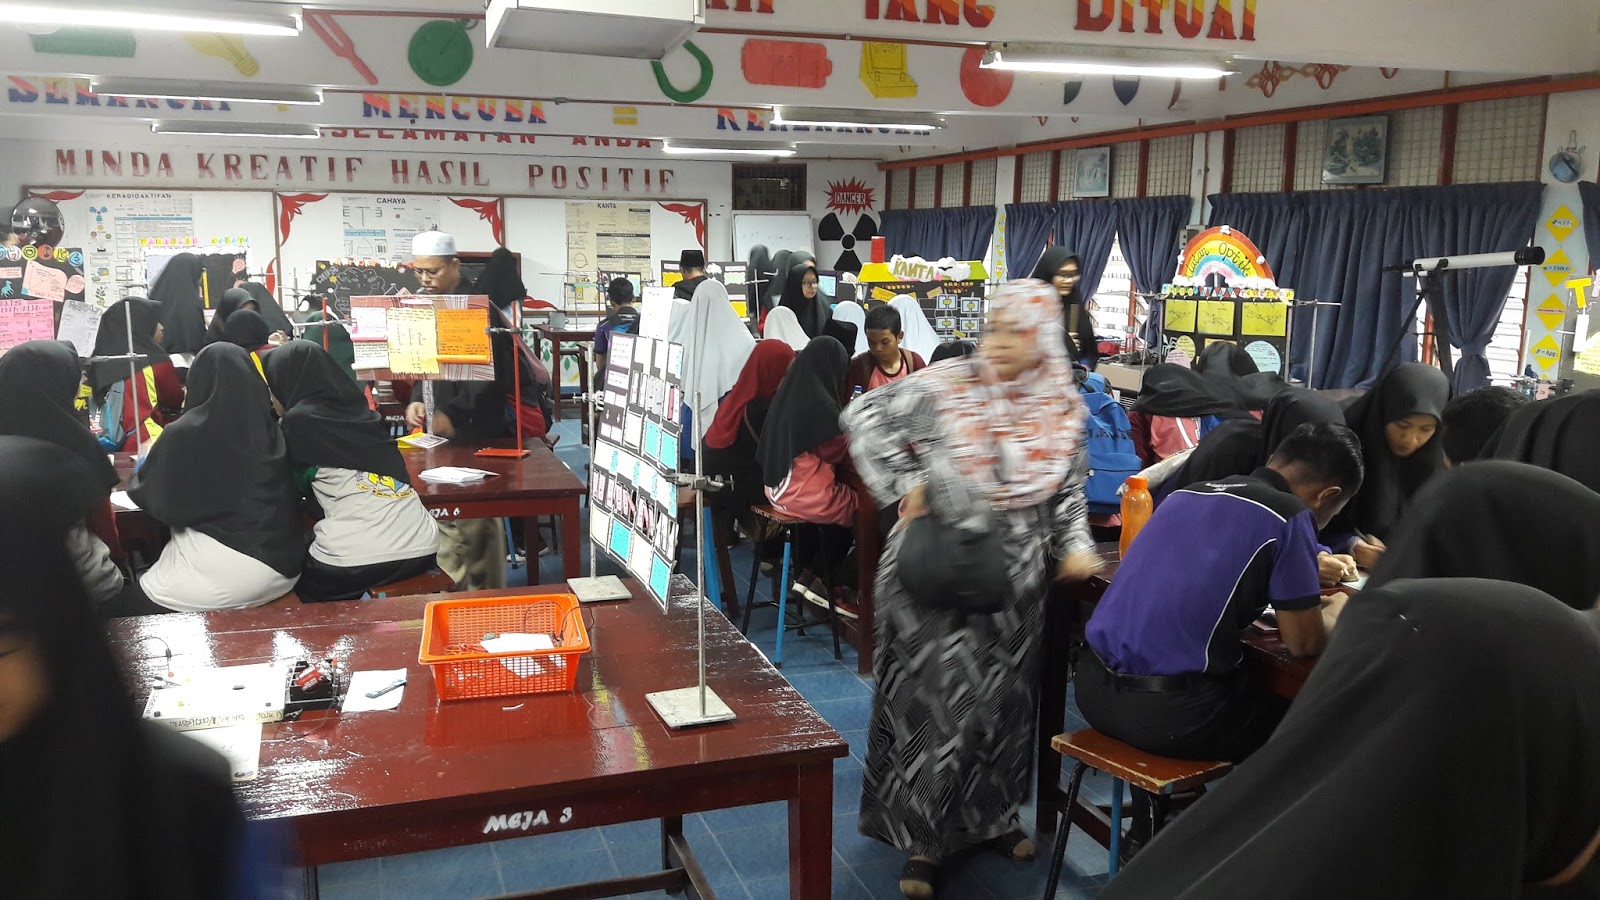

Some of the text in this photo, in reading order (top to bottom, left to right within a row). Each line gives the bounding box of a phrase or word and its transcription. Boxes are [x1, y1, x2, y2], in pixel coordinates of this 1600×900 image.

[362, 92, 547, 124] MENCUBA
[56, 149, 674, 193] MINDA KREATIF HASIL POSITIF
[835, 193, 865, 204] DANGER
[1218, 242, 1252, 278] Optik
[428, 507, 460, 518] EJA 6
[482, 806, 573, 834] MEJA 3
